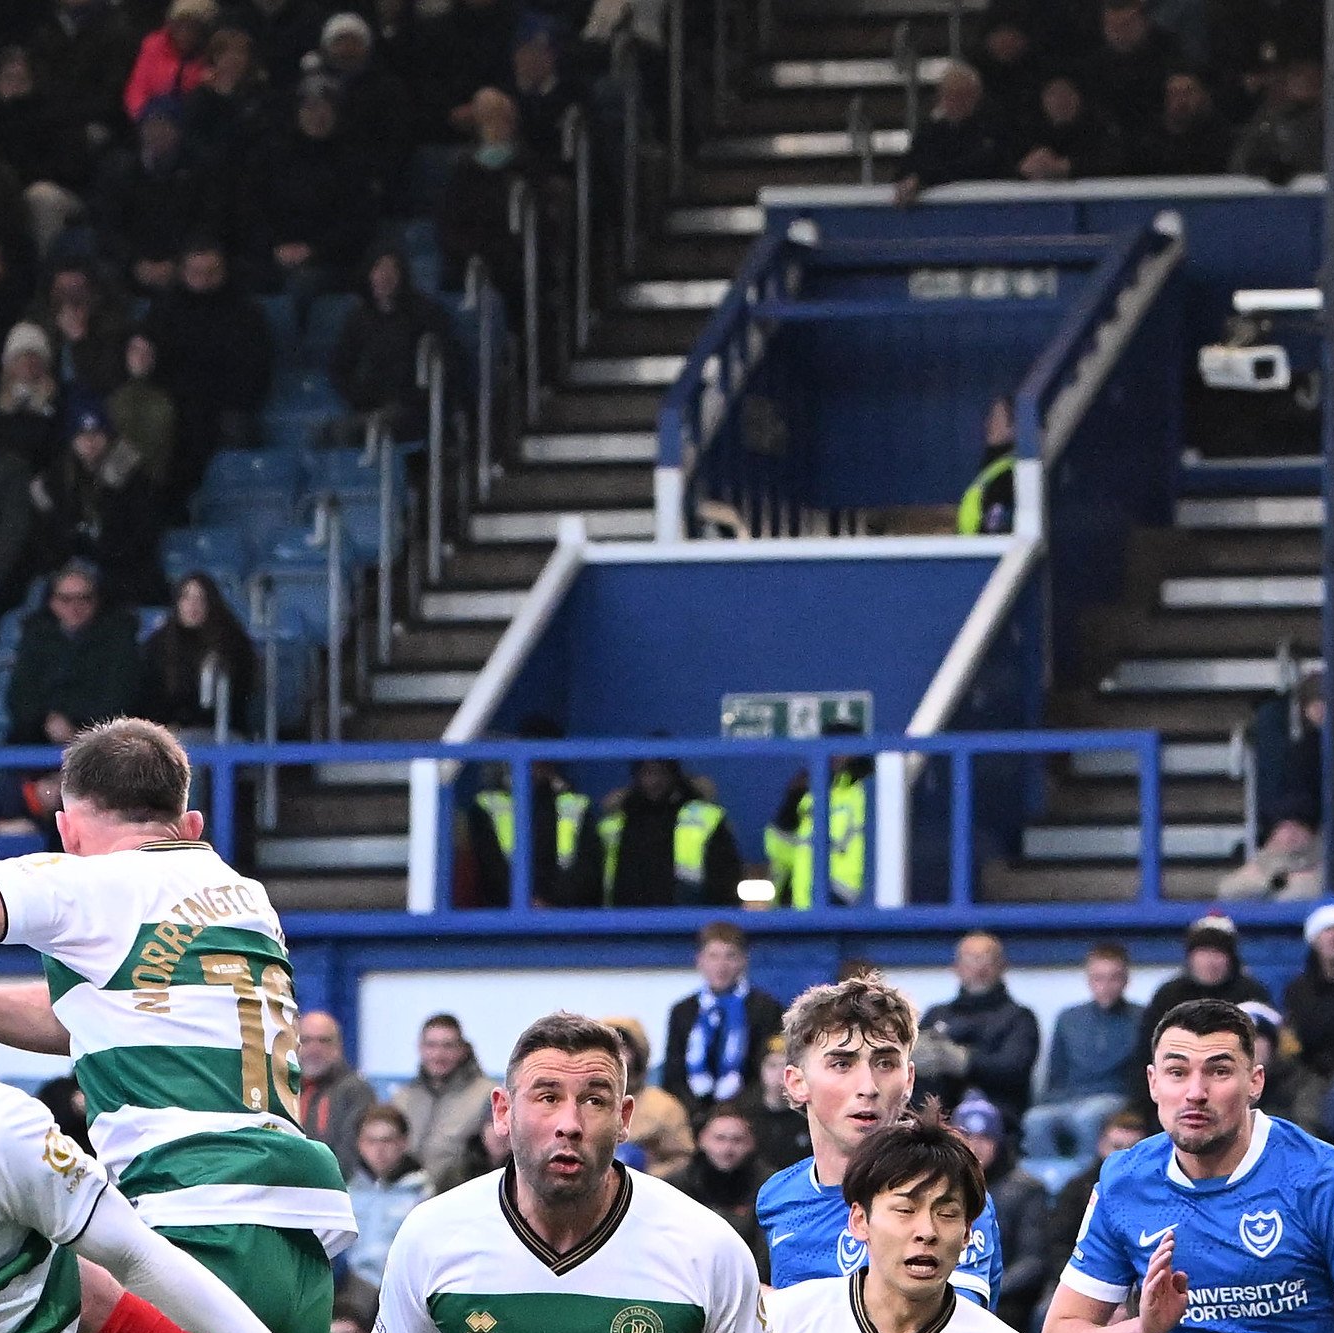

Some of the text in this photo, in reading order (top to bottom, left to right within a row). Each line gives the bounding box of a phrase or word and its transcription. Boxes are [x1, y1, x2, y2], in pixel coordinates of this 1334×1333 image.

[131, 884, 260, 1014] NORRINGTO
[1179, 1291, 1308, 1324] PORTSMOUTH
[1187, 1279, 1306, 1304] NIVERSITY OF
